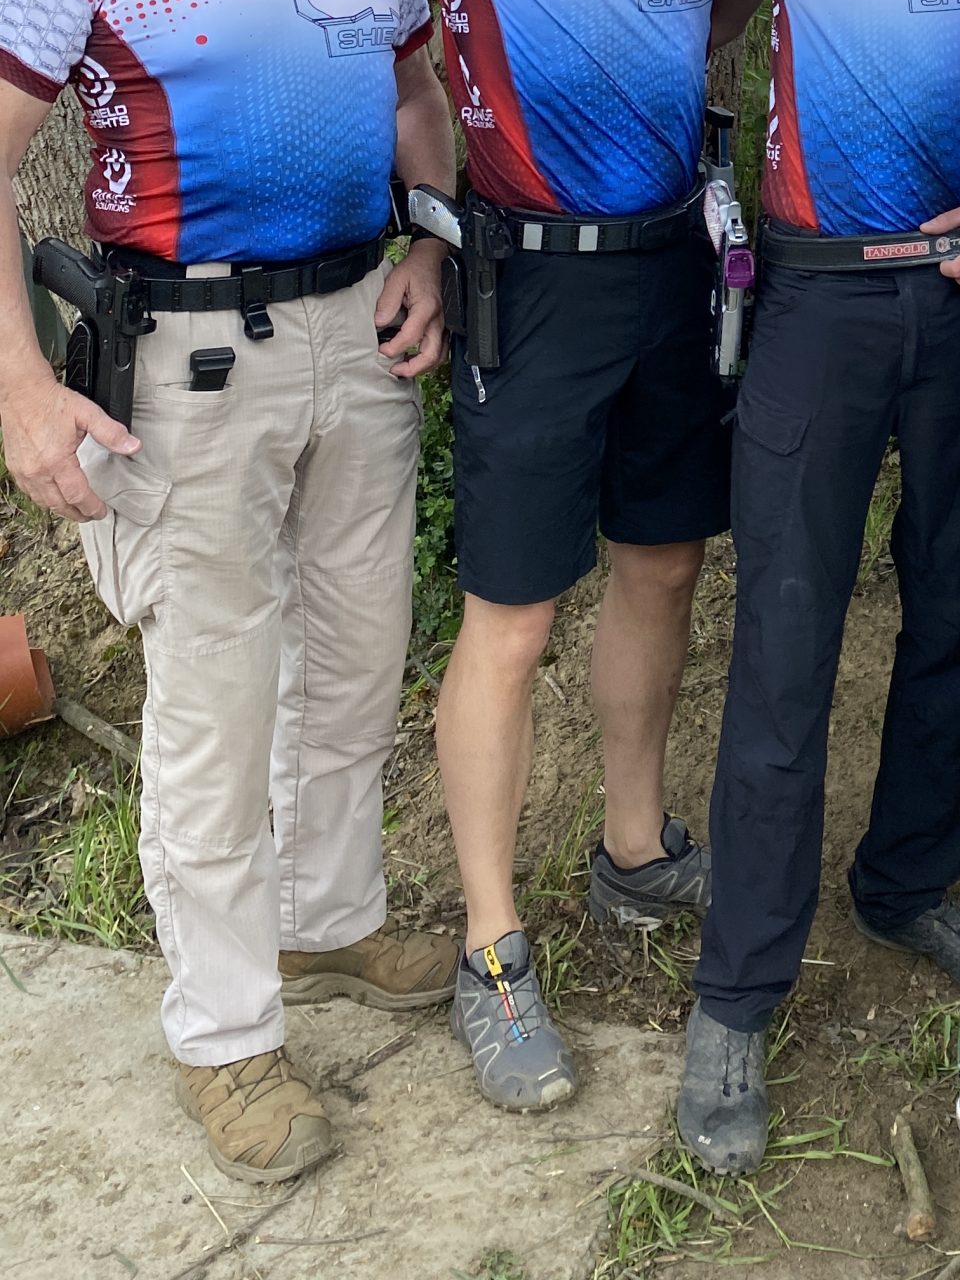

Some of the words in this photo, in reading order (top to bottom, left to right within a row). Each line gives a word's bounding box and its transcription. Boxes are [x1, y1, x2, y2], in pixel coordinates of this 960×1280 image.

[338, 26, 397, 50] SHIE
[95, 202, 130, 213] SOLUTIONS
[866, 244, 928, 257] TANFOGLIO
